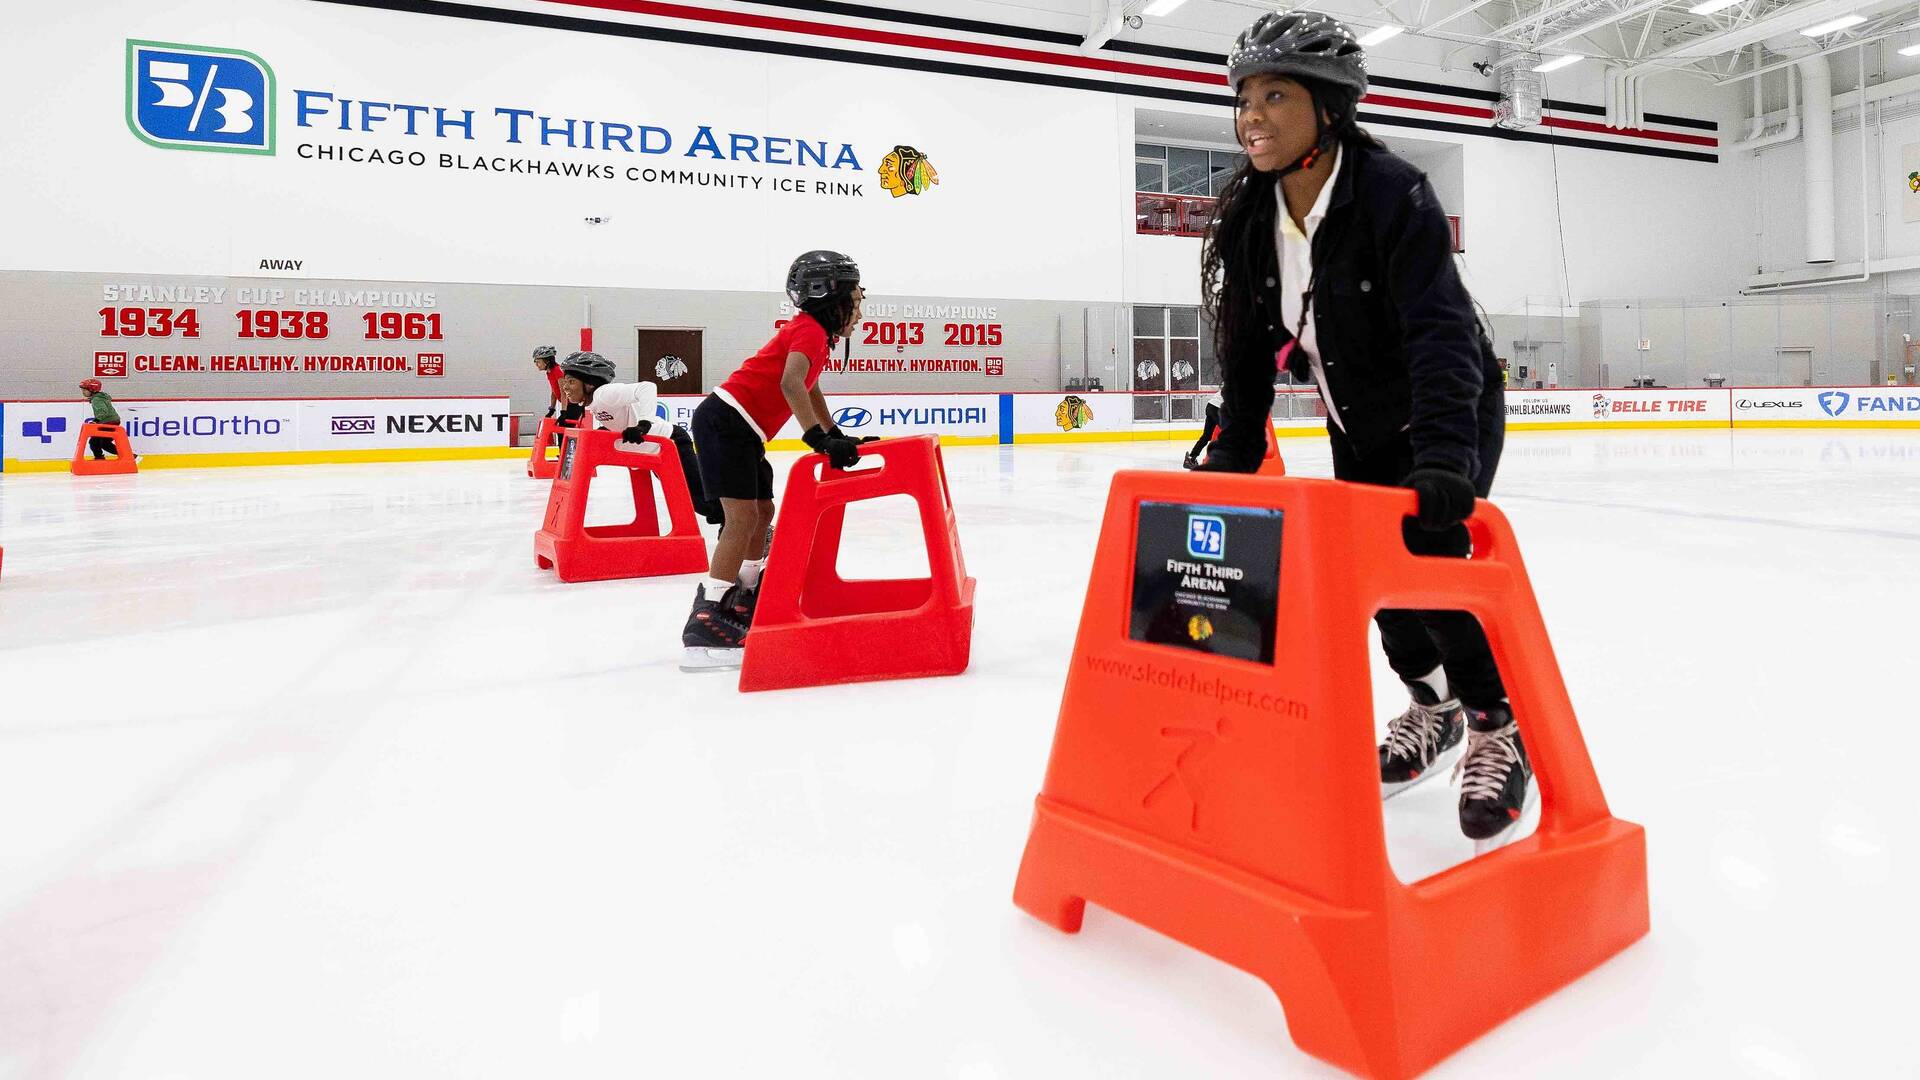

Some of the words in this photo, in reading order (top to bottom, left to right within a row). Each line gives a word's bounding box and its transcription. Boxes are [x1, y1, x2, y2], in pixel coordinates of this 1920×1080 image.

[293, 89, 475, 140] FIFTH
[495, 107, 672, 154] THIRD
[684, 126, 863, 170] ARENA
[297, 143, 426, 166] CHICAGO
[439, 153, 615, 179] BLACKHAWKS
[626, 167, 763, 190] COMMUNITY
[773, 178, 805, 193] ICE
[816, 181, 863, 197] RINK
[259, 259, 303, 271] AWAY
[103, 284, 227, 304] STANLEY
[236, 287, 285, 305] CUP
[295, 288, 437, 308] CHAMPIONS
[864, 303, 898, 318] CUP
[903, 304, 997, 320] CHAMPIONS
[98, 306, 201, 338] 1934
[235, 309, 329, 339] 1938
[362, 311, 444, 341] 1961
[862, 321, 925, 346] 2013
[944, 323, 1002, 346] 2015
[98, 354, 124, 363] BIO
[133, 354, 206, 372] CLEAN.
[210, 354, 299, 373] HEALTHY.
[304, 355, 412, 373] HYDRATION.
[420, 356, 441, 364] BIO
[849, 359, 906, 372] HEALTHY.
[910, 359, 982, 372] HYDRATION.
[880, 407, 986, 425] HYUNDAI
[1612, 400, 1662, 413] BELLE
[1667, 400, 1707, 412] TIRE
[386, 414, 483, 434] NEXEN
[1166, 558, 1202, 576] FIFTH
[1203, 563, 1244, 581] THIRD
[1180, 574, 1226, 593] ARENA
